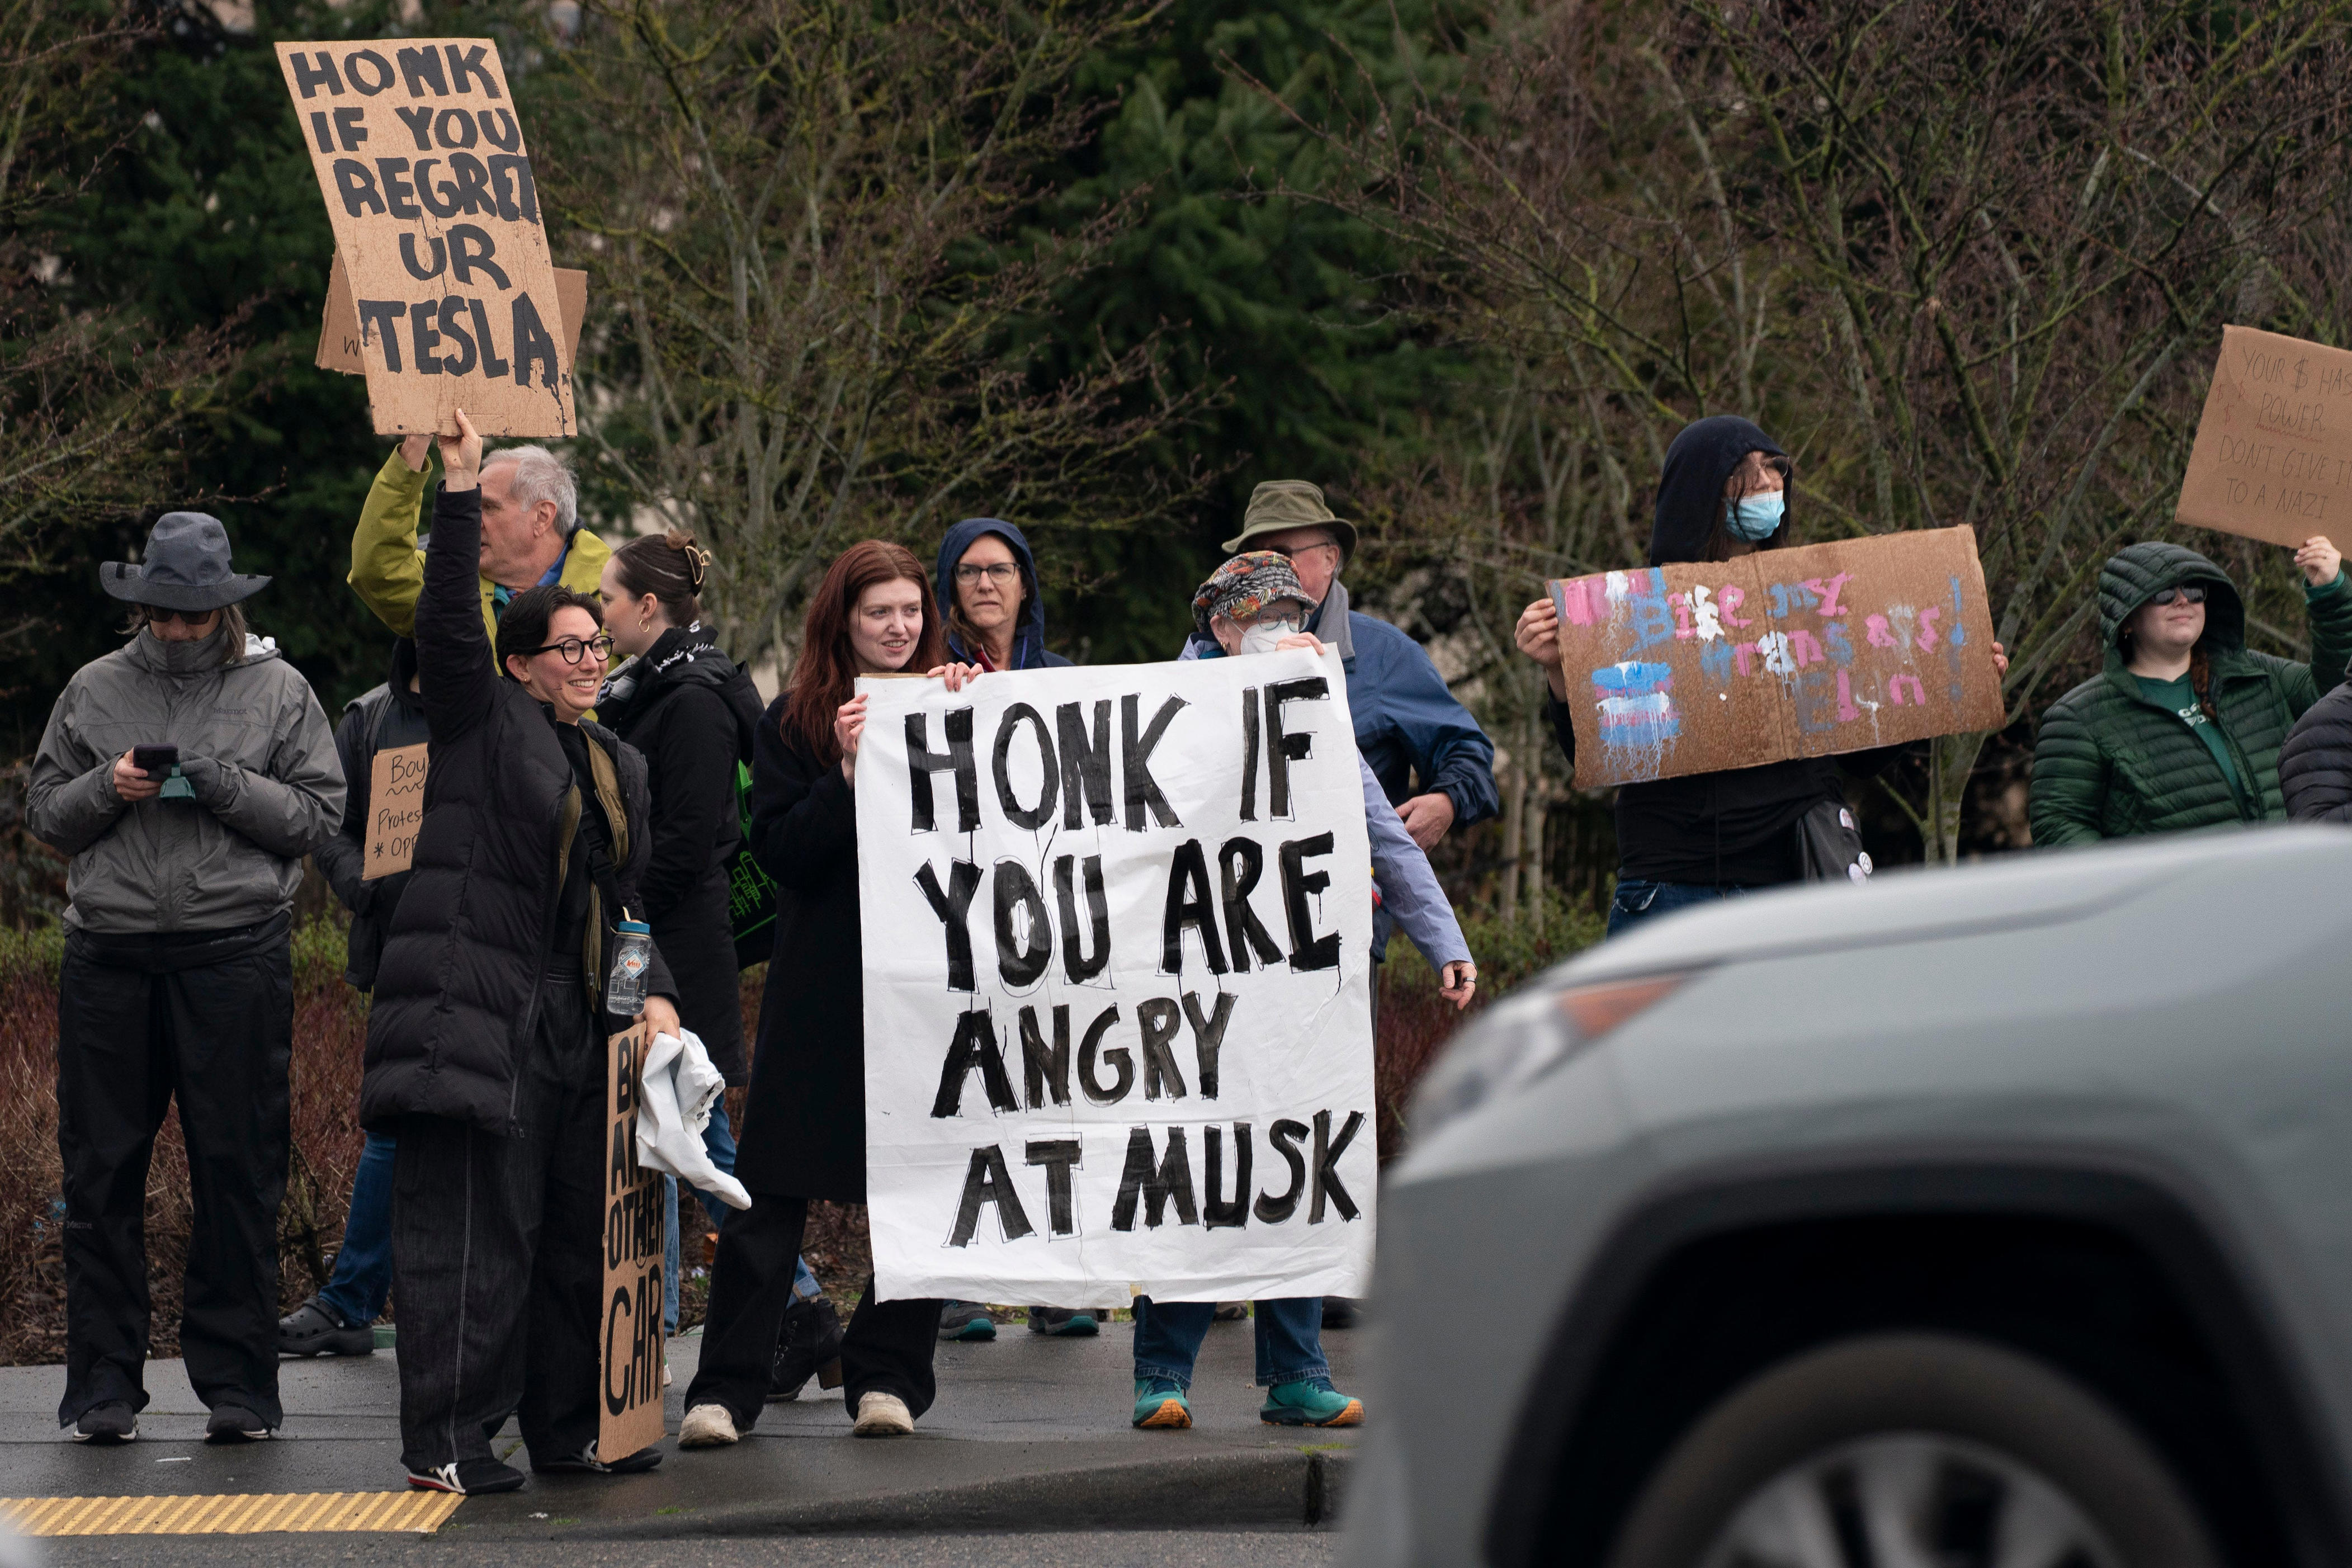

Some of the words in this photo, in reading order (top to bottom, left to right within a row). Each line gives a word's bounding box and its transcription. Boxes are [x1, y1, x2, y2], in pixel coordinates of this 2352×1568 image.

[289, 44, 502, 100] HONK
[310, 106, 368, 154] IF
[394, 106, 521, 153] YOU
[398, 224, 512, 290] UR
[358, 291, 560, 388] TESLA
[2242, 346, 2285, 385] YOUR
[2226, 478, 2249, 506] TO
[2255, 484, 2266, 506] A
[2282, 447, 2329, 480] GIVE
[391, 755, 428, 783] Boy
[905, 693, 1191, 835] HONK
[1239, 676, 1330, 823] IF
[378, 809, 423, 835] Protes
[912, 854, 1117, 996] YOU
[1157, 830, 1342, 976] ARE
[931, 991, 1238, 1118] ANGRY
[941, 1132, 1083, 1248] AT
[1110, 1108, 1366, 1232] MUSK
[607, 1171, 665, 1271] OTHER
[605, 1263, 662, 1416] CAR
